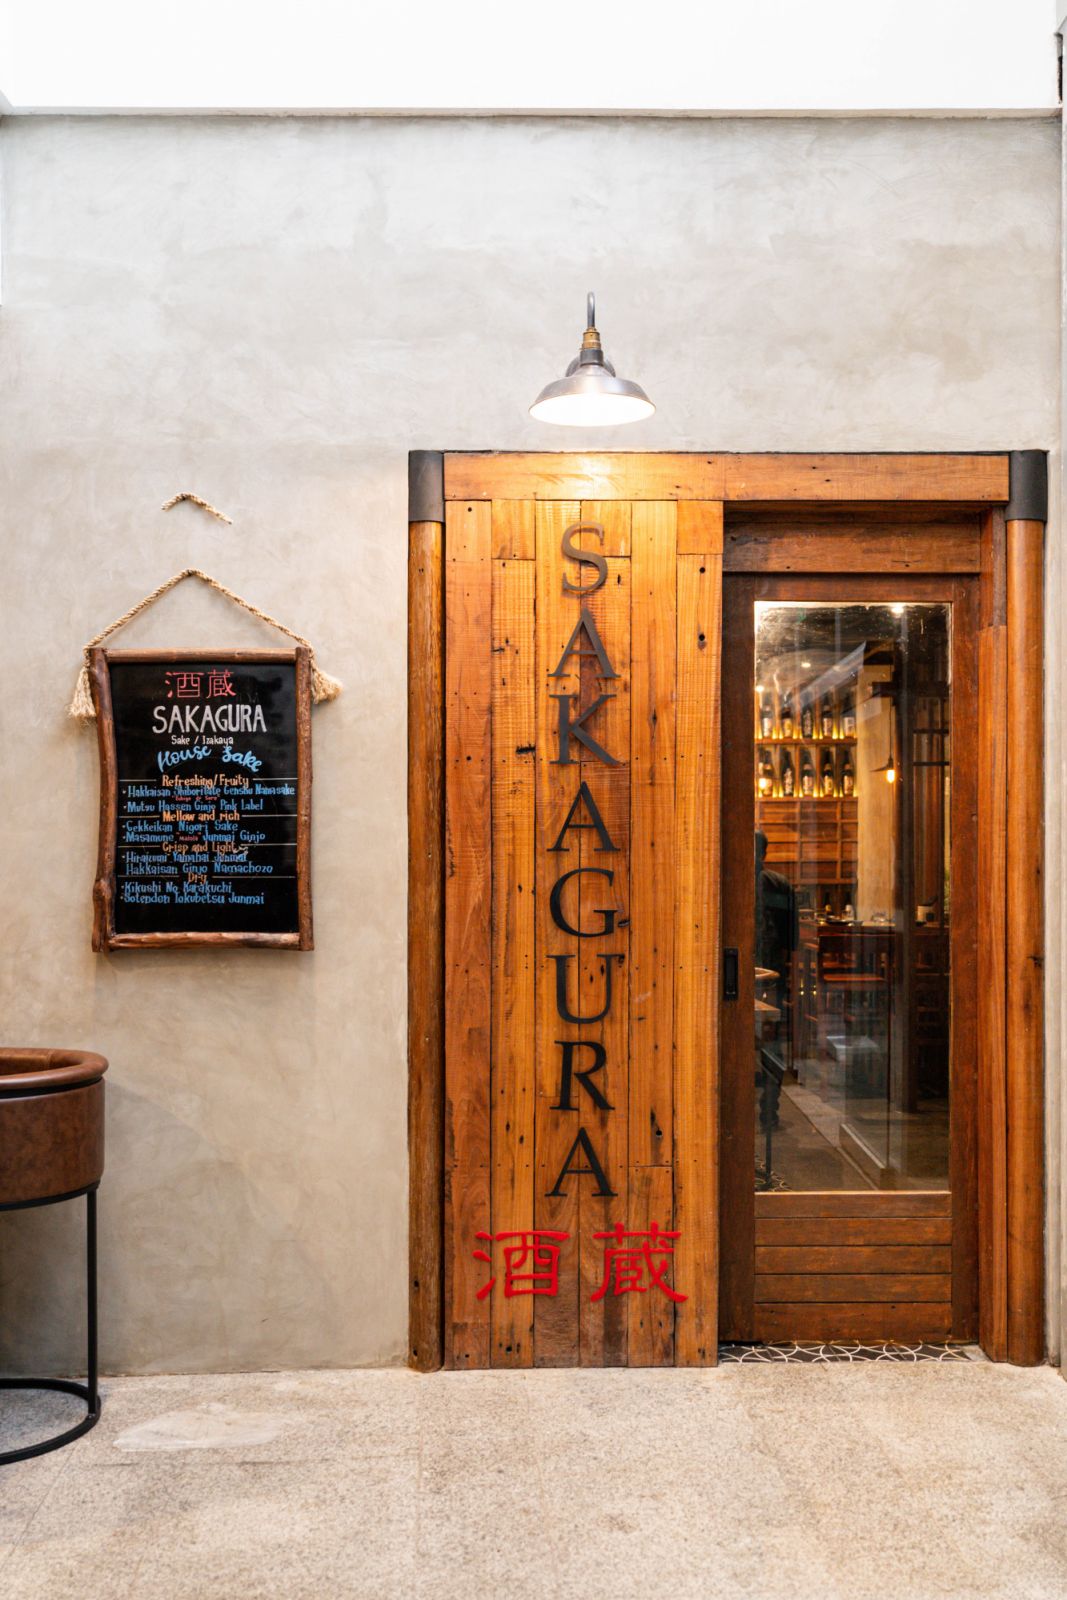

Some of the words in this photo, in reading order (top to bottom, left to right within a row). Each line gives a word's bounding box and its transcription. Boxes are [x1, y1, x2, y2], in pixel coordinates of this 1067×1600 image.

[165, 669, 236, 699] 酒蔵
[152, 704, 267, 734] SAKAGURA
[171, 735, 190, 745] Sake
[202, 735, 234, 747] Izakaya
[157, 745, 212, 773] House
[222, 745, 262, 773] Sake
[220, 798, 237, 811] Pink
[241, 798, 263, 811] Label
[162, 810, 195, 822] Mellow
[198, 809, 215, 821] and
[220, 809, 240, 821] rich
[214, 819, 238, 831] Sake
[191, 841, 208, 852] and
[546, 520, 622, 1198] SAKAGURA
[126, 862, 178, 875] Hakkaisan
[214, 861, 273, 873] Namachozo
[165, 881, 178, 893] No
[228, 891, 264, 904] Junmai
[472, 1222, 689, 1303] 酒蔵
